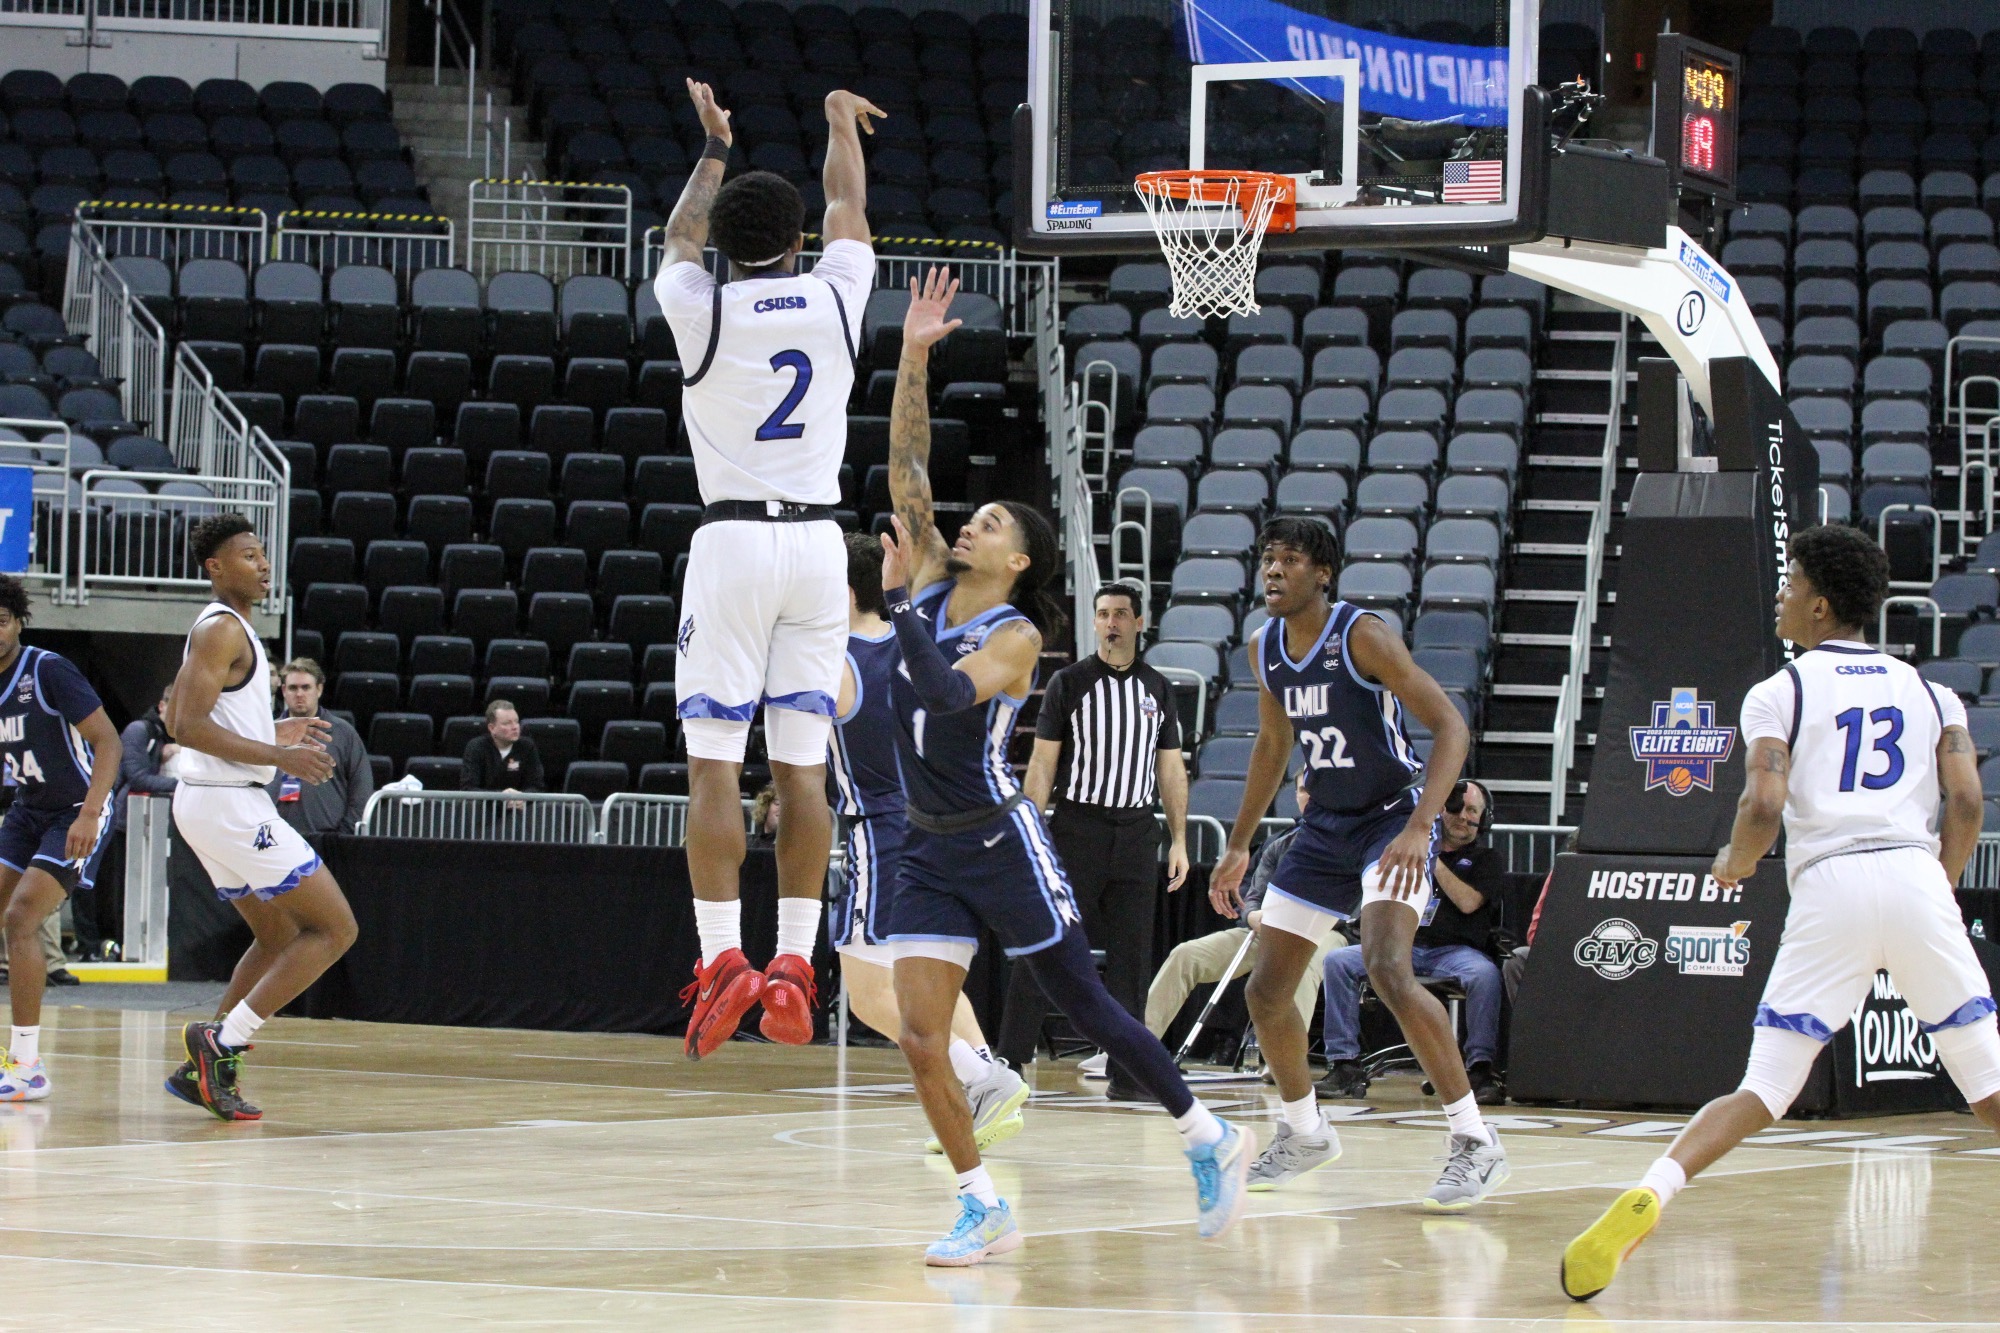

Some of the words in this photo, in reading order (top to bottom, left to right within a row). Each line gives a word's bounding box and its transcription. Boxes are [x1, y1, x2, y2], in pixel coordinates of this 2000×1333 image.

[1047, 218, 1091, 231] SPALDING
[754, 296, 807, 313] CSUSB
[755, 349, 813, 441] 2
[1768, 419, 1795, 662] TicketSmaer
[1835, 665, 1888, 675] CSUSB
[1284, 683, 1334, 719] LMU
[1300, 726, 1355, 770] 22
[1640, 736, 1680, 753] ELITE
[1681, 736, 1726, 753] EIGHT
[1835, 705, 1905, 792] 13
[5, 750, 46, 785] 24
[1587, 870, 1697, 902] HOSTED
[1577, 940, 1655, 966] GLVC
[1666, 934, 1749, 972] sports
[1687, 964, 1743, 973] COMMISSION
[1873, 973, 1902, 1000] MA
